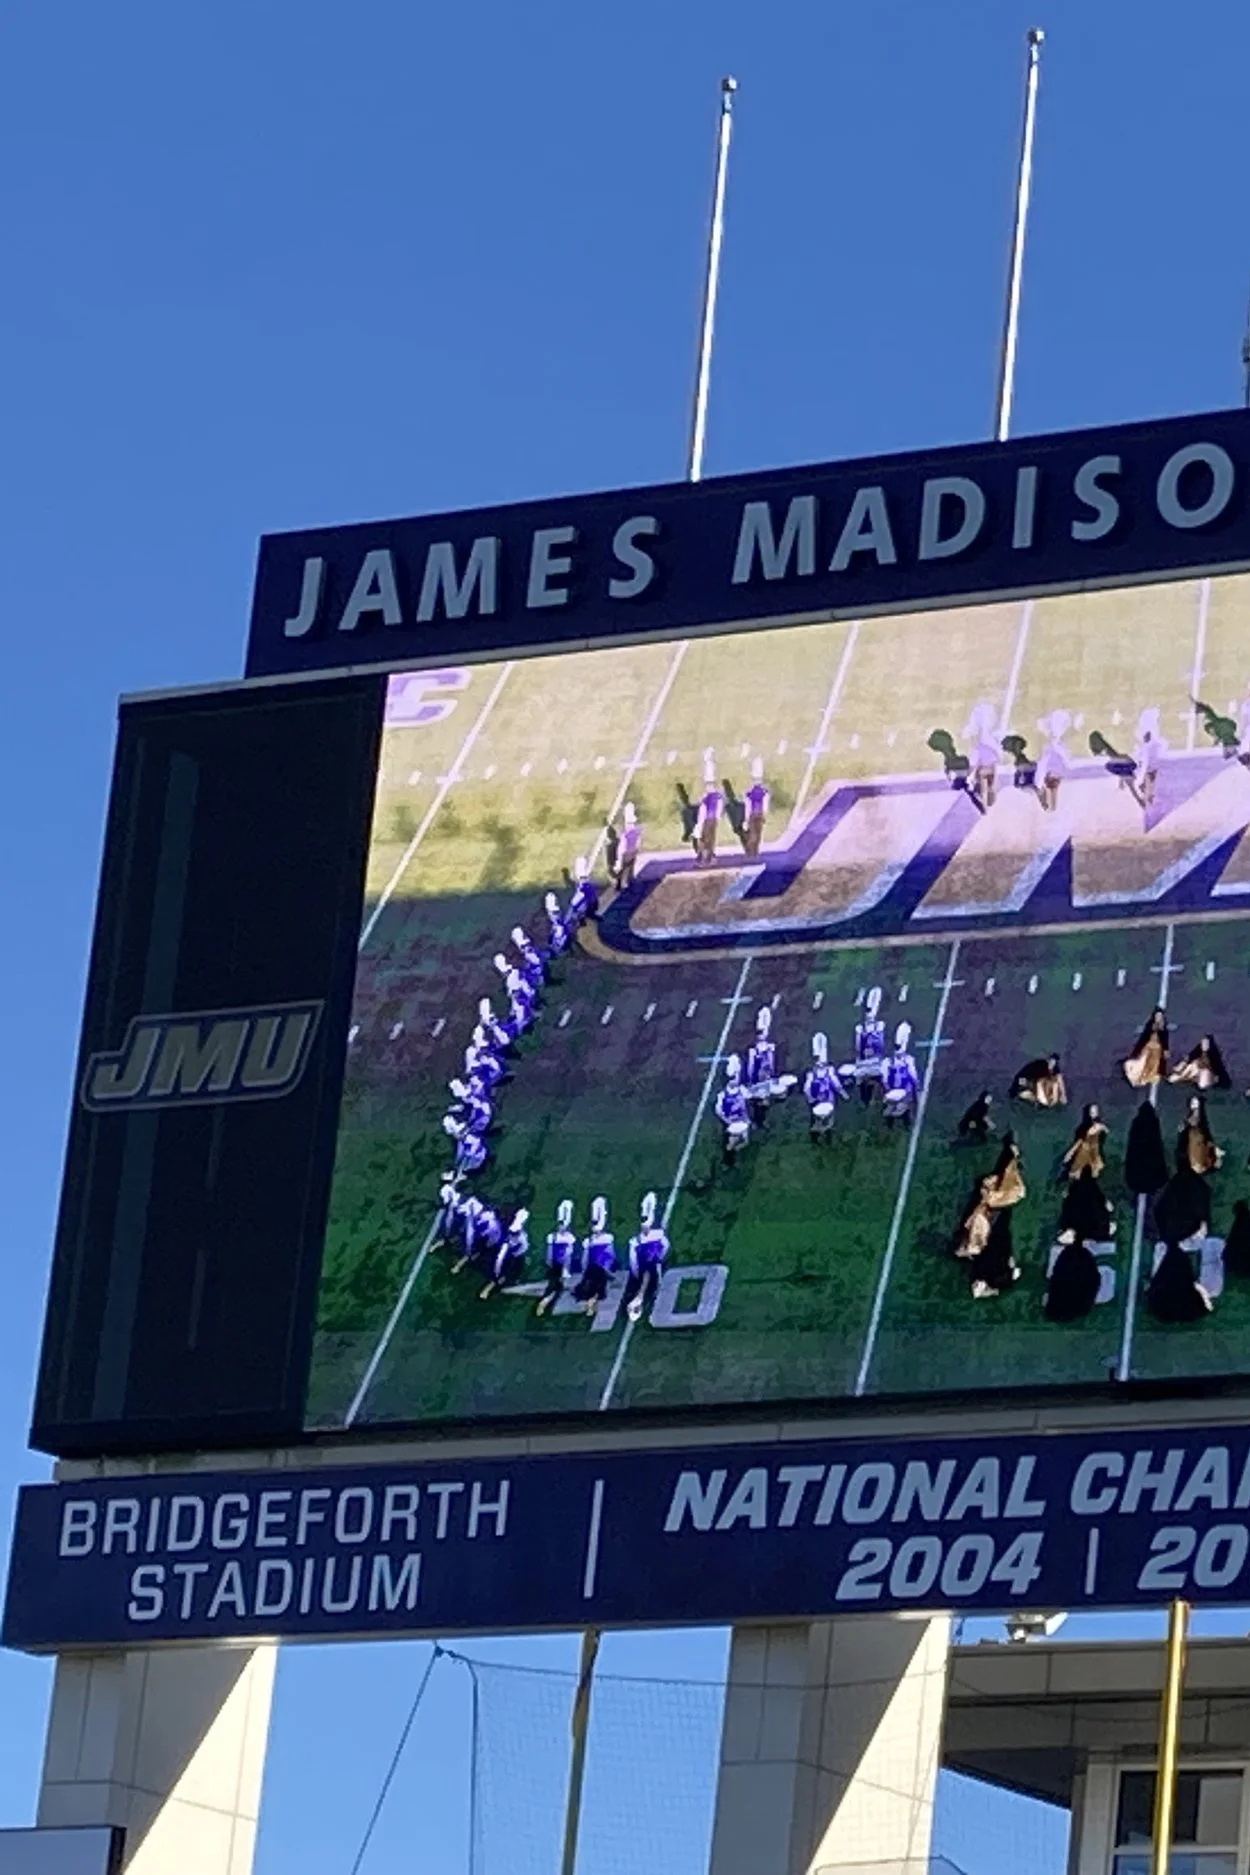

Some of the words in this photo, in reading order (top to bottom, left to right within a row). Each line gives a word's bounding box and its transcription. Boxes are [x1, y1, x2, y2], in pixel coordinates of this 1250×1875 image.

[284, 516, 658, 637] JAMES
[88, 1006, 316, 1105] JMU
[58, 1479, 512, 1557] BRIDGEFORTH
[663, 1456, 1045, 1532] NATIONAL
[127, 1553, 422, 1622] STADIUM
[835, 1529, 1042, 1599] 2004
